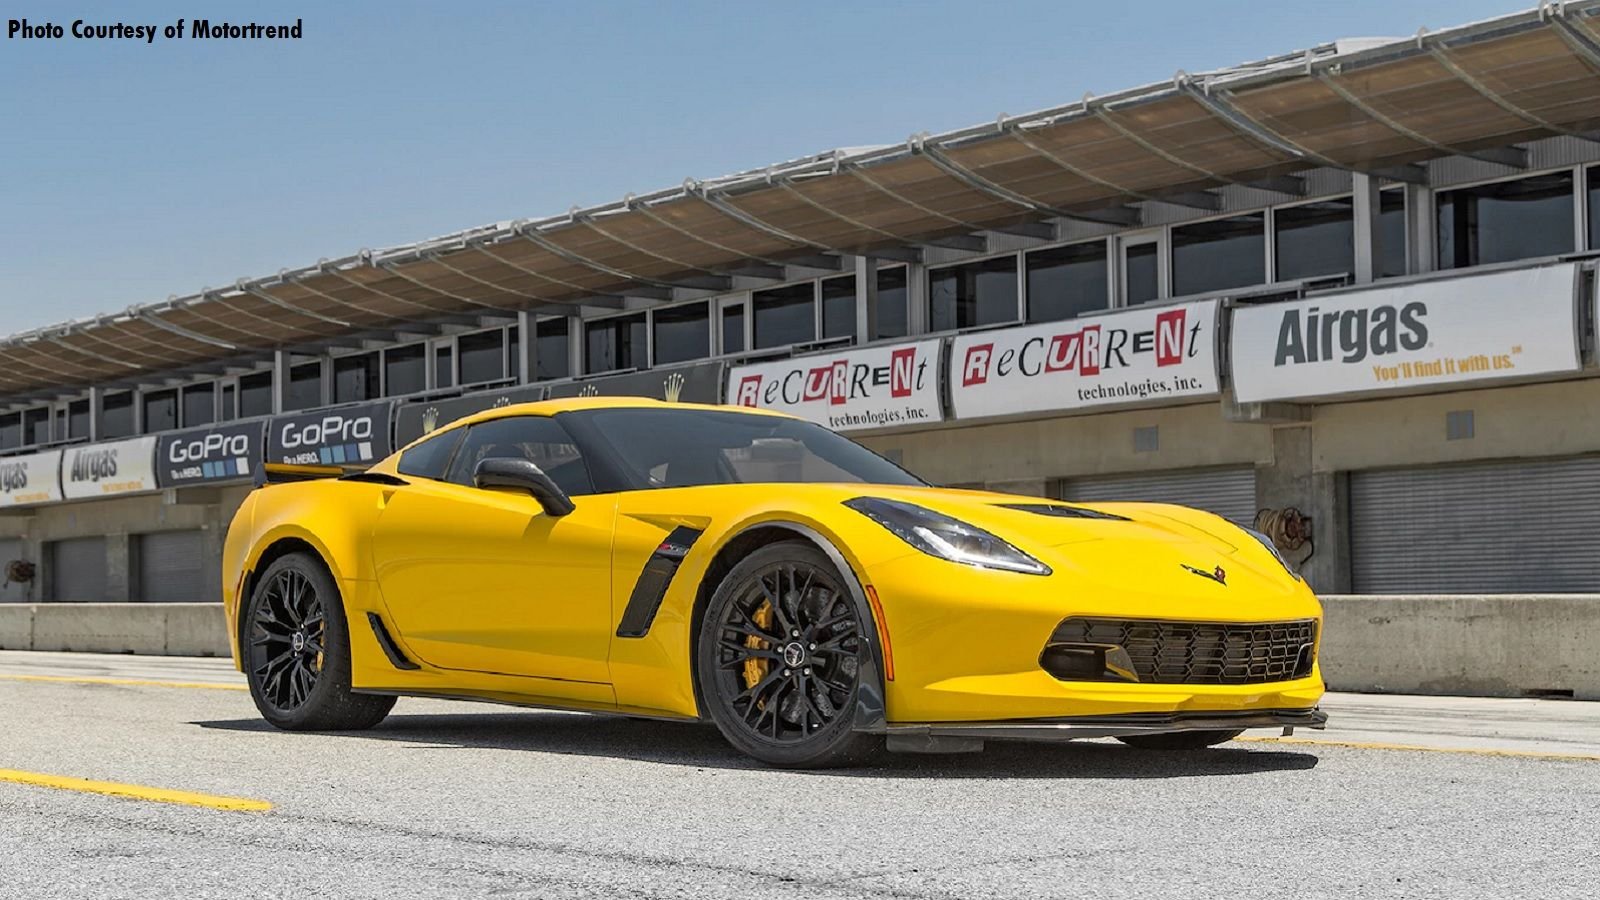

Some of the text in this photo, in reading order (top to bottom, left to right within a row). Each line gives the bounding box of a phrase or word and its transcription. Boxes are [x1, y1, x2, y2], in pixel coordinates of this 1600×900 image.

[1274, 301, 1428, 367] Airgas
[1372, 353, 1515, 382] You'll find it with us.
[1078, 375, 1203, 401] technologies, inc.
[829, 405, 929, 428] technologies, inc.
[281, 416, 372, 448] GoPro
[169, 433, 249, 463] GoPro
[70, 447, 118, 482] Airgas
